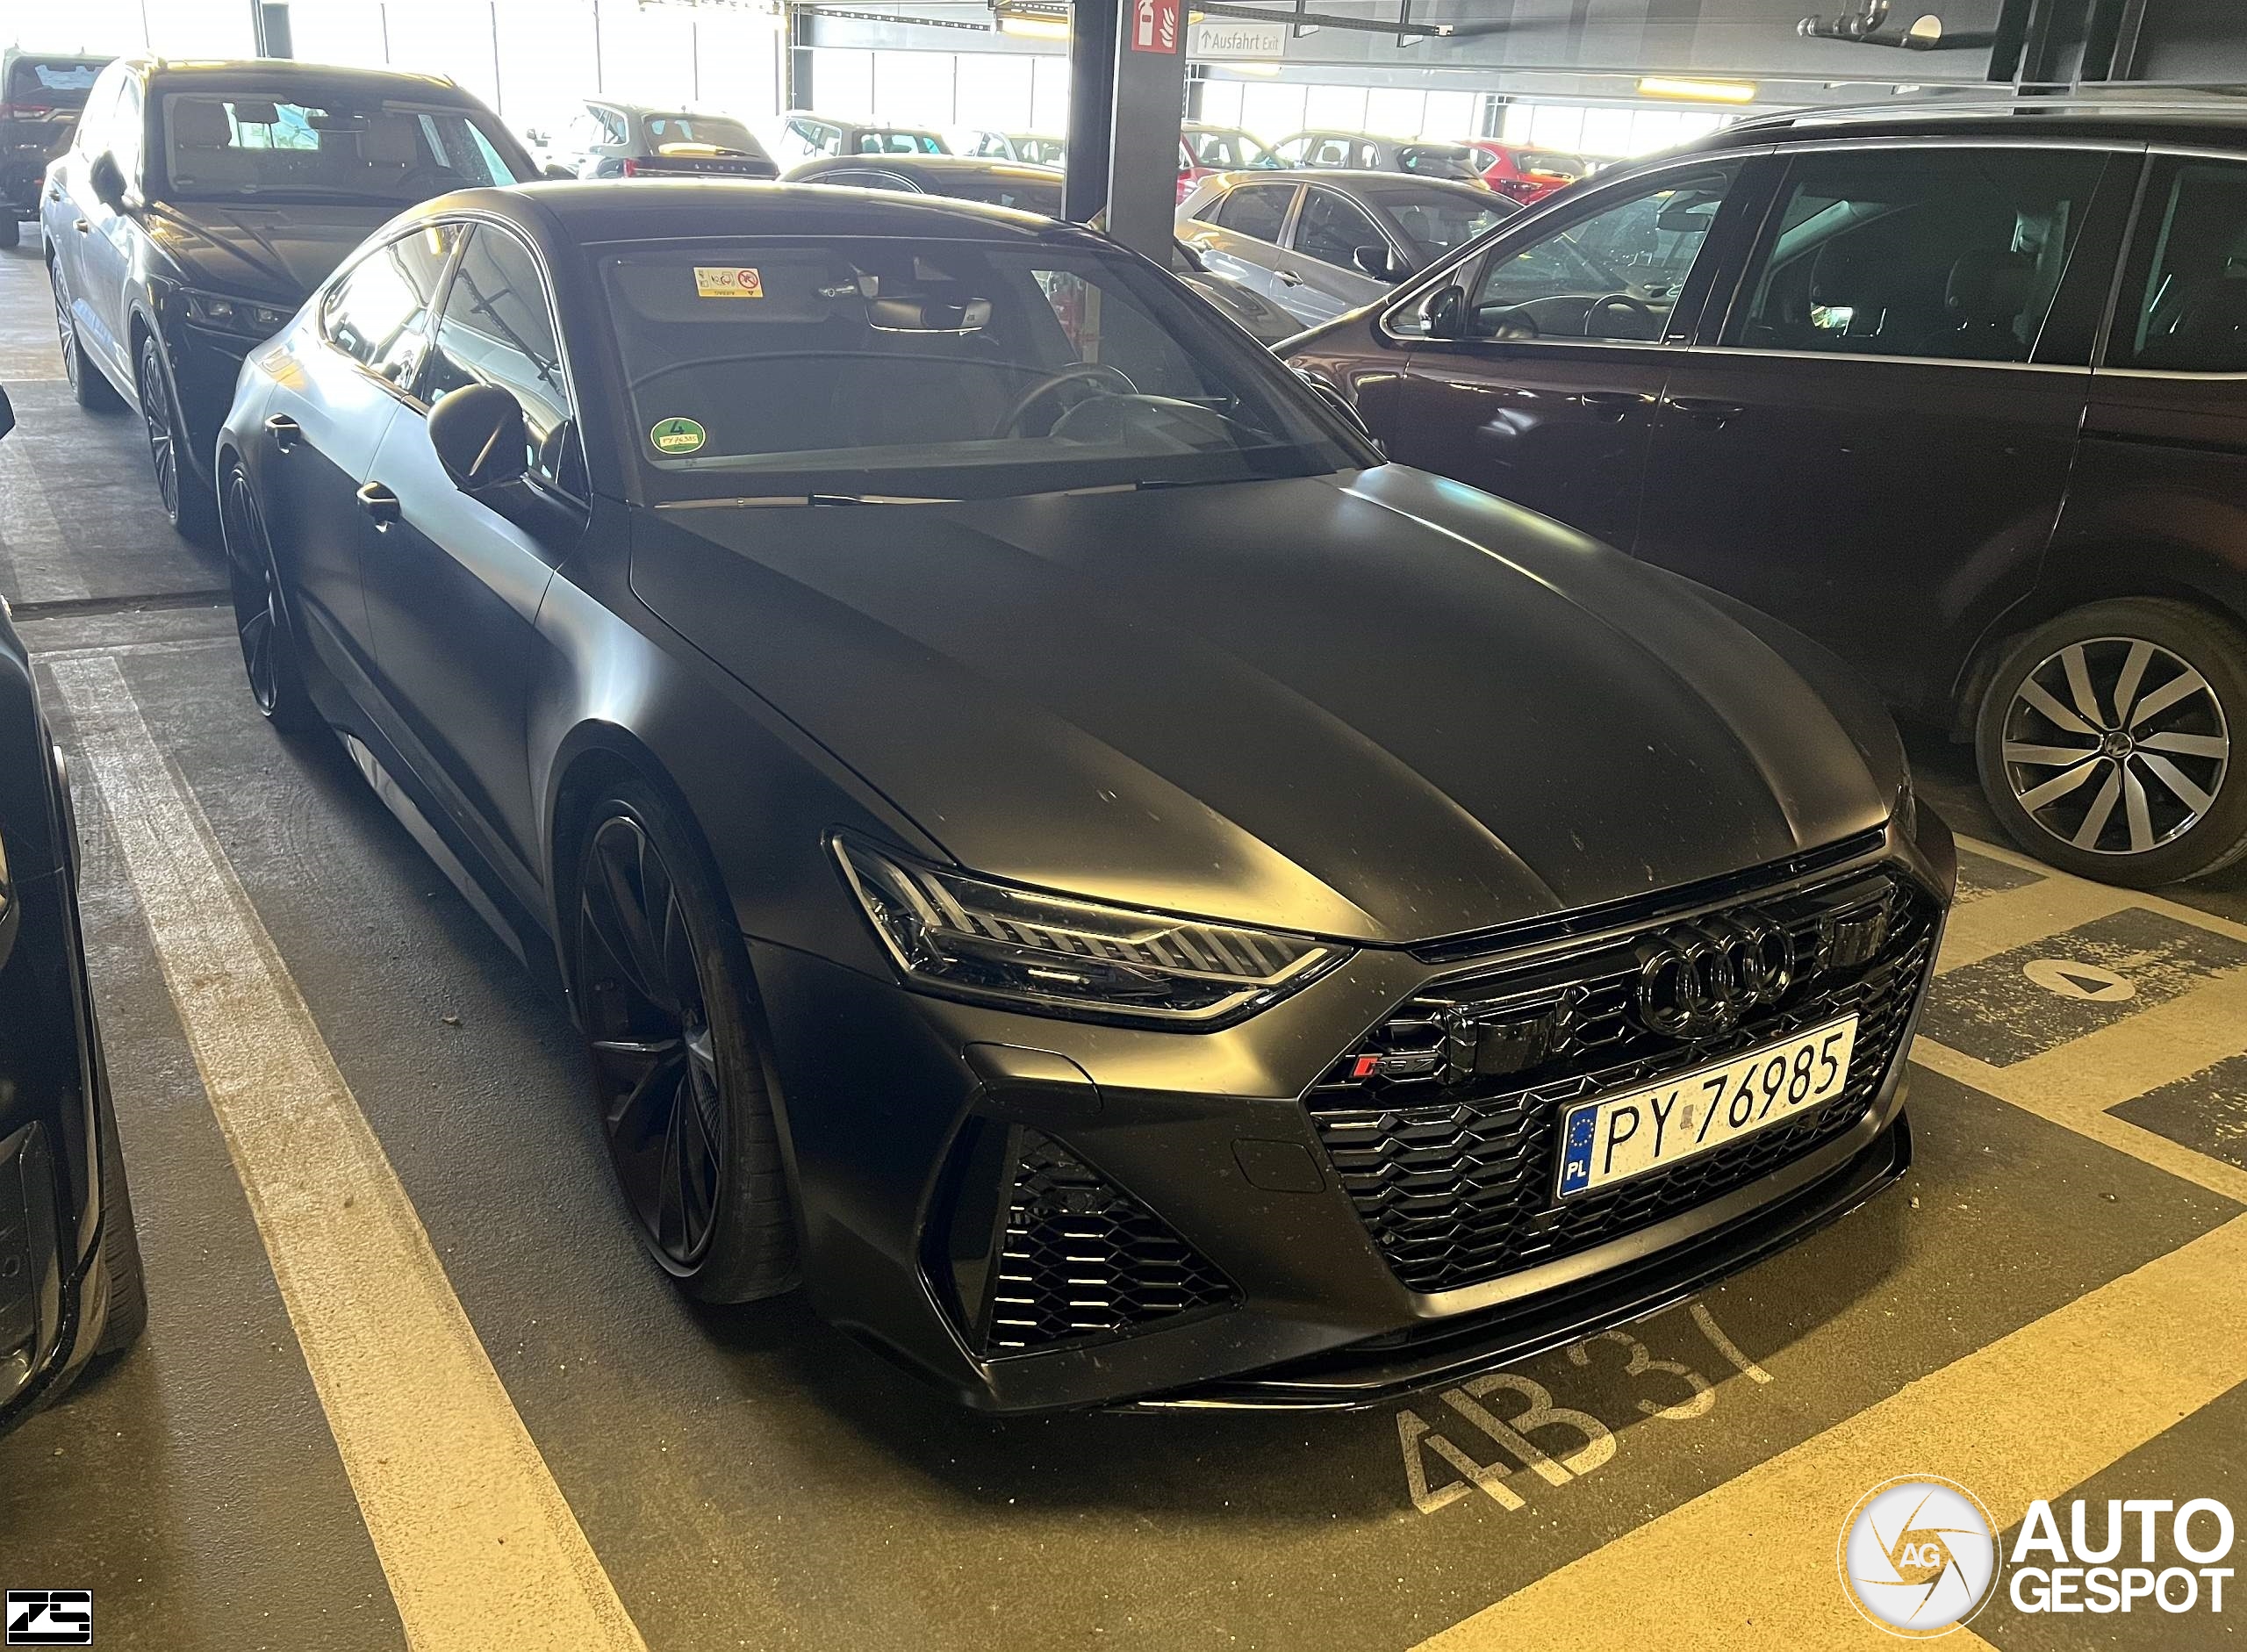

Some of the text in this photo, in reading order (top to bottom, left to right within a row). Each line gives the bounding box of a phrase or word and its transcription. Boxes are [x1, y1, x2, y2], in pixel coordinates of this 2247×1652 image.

[1211, 32, 1278, 50] Ausfahrt Exit
[670, 420, 685, 435] 4
[1603, 1031, 1843, 1174] PY 76985
[1566, 1160, 1587, 1181] PL
